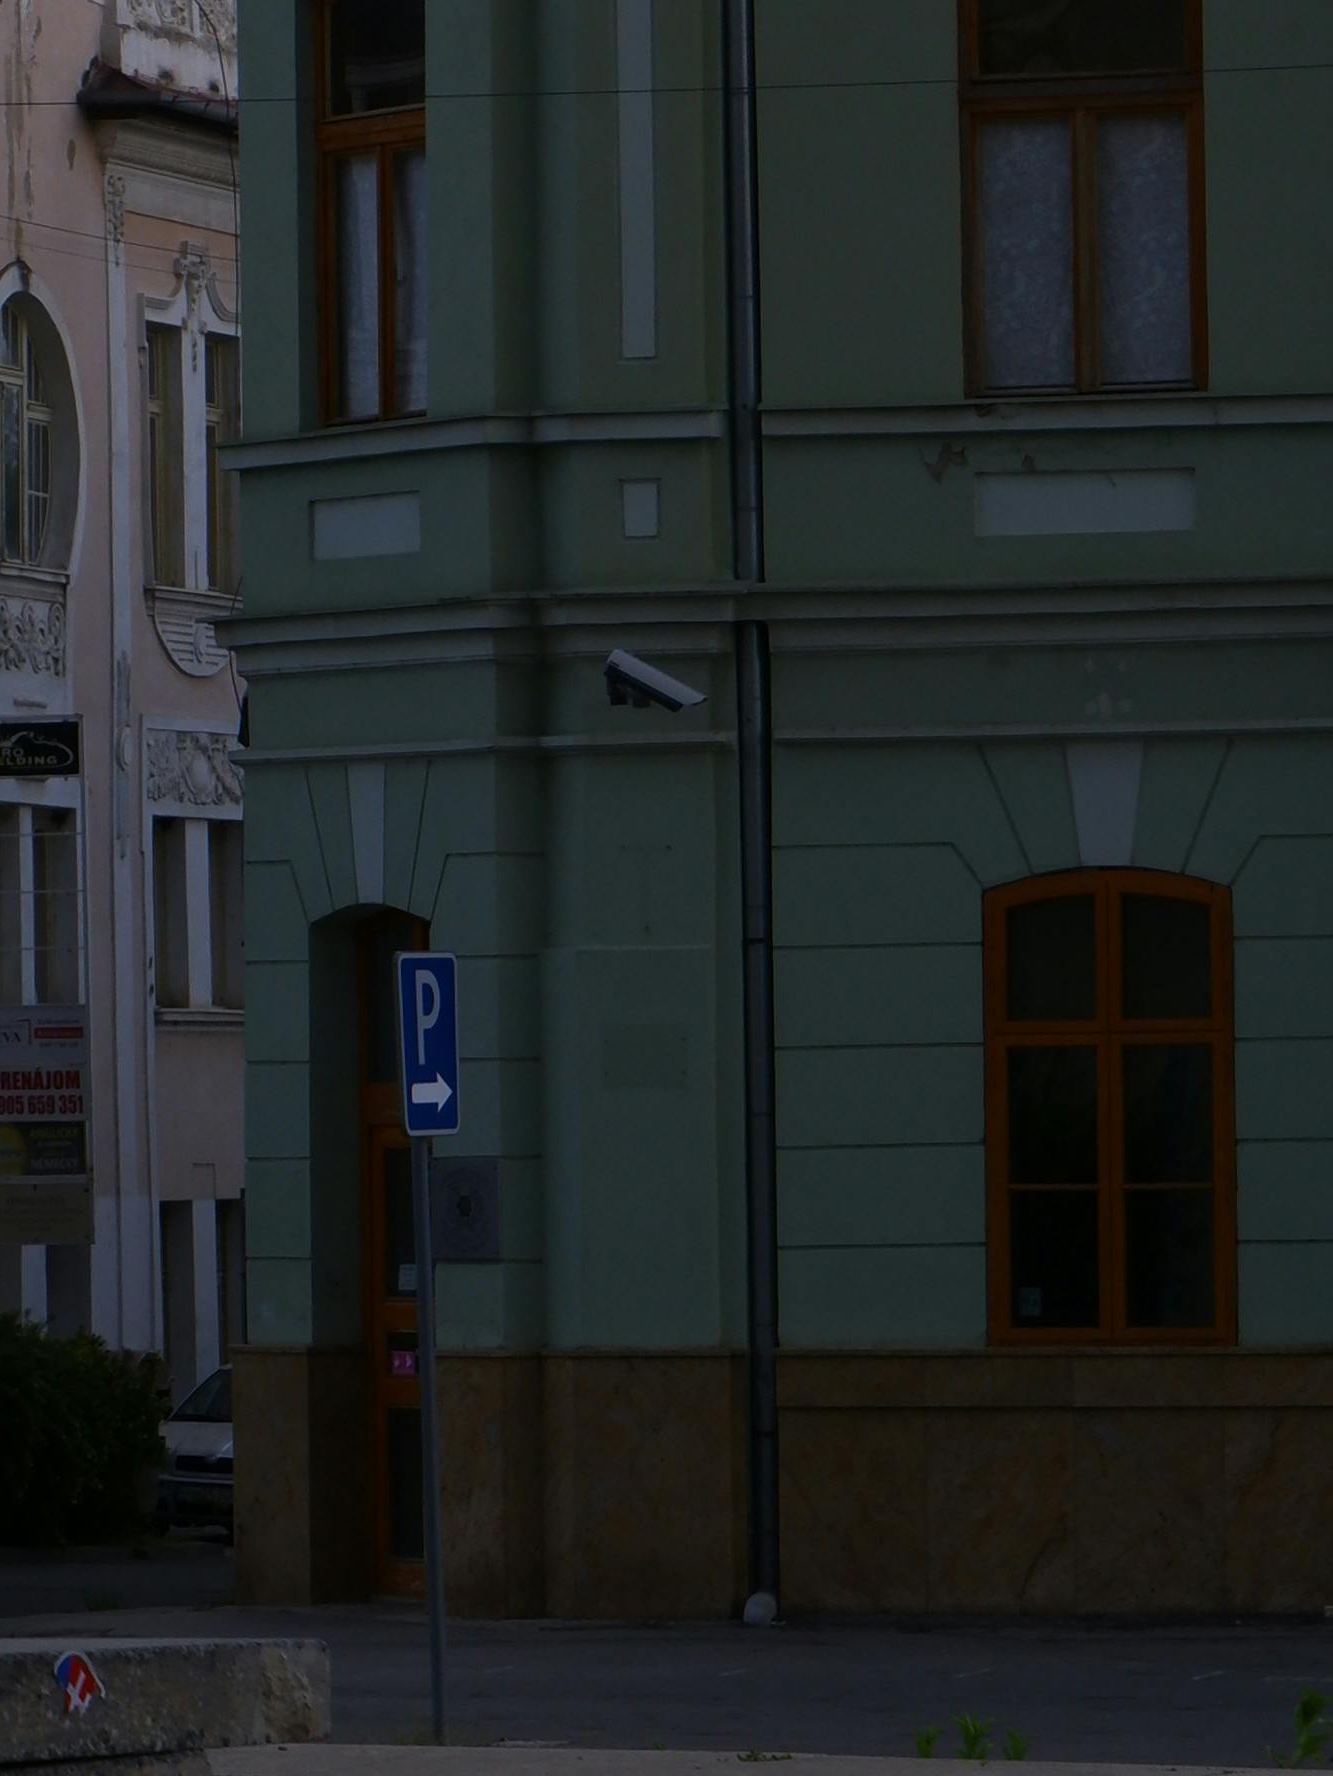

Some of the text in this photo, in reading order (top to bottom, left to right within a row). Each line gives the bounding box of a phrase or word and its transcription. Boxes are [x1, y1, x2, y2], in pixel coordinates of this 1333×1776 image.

[415, 968, 441, 1065] P
[27, 1095, 55, 1116] 659
[58, 1094, 85, 1116] 351
